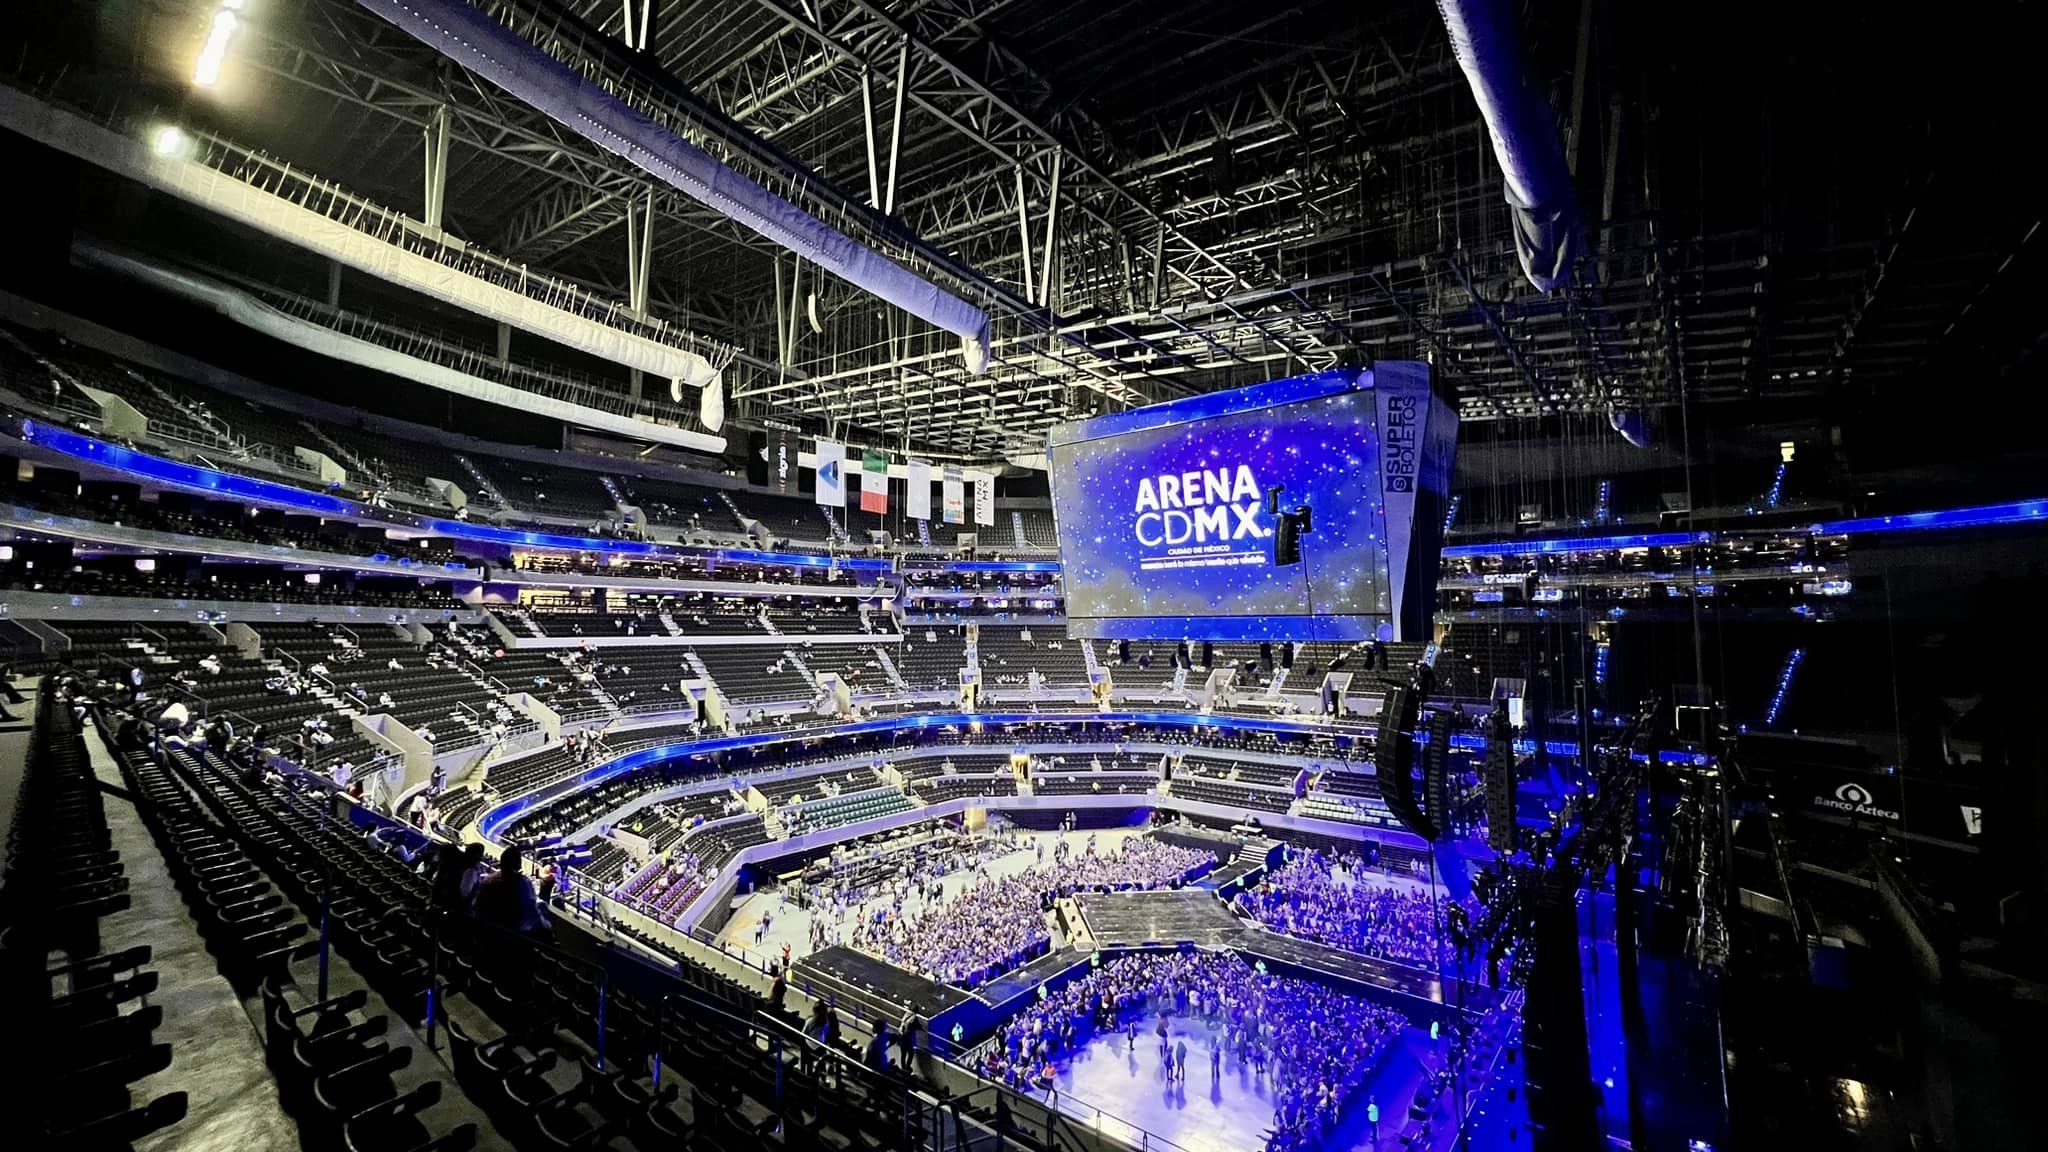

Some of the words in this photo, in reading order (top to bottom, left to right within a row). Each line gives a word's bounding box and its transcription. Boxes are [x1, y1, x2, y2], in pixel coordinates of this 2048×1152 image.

[1387, 396, 1402, 474] SUPER
[1402, 396, 1416, 474] BOLETOS
[1135, 464, 1261, 514] ARENA
[1167, 547, 1193, 555] CIUDAD
[1814, 796, 1853, 811] Banco
[1855, 803, 1900, 820] Azteca
